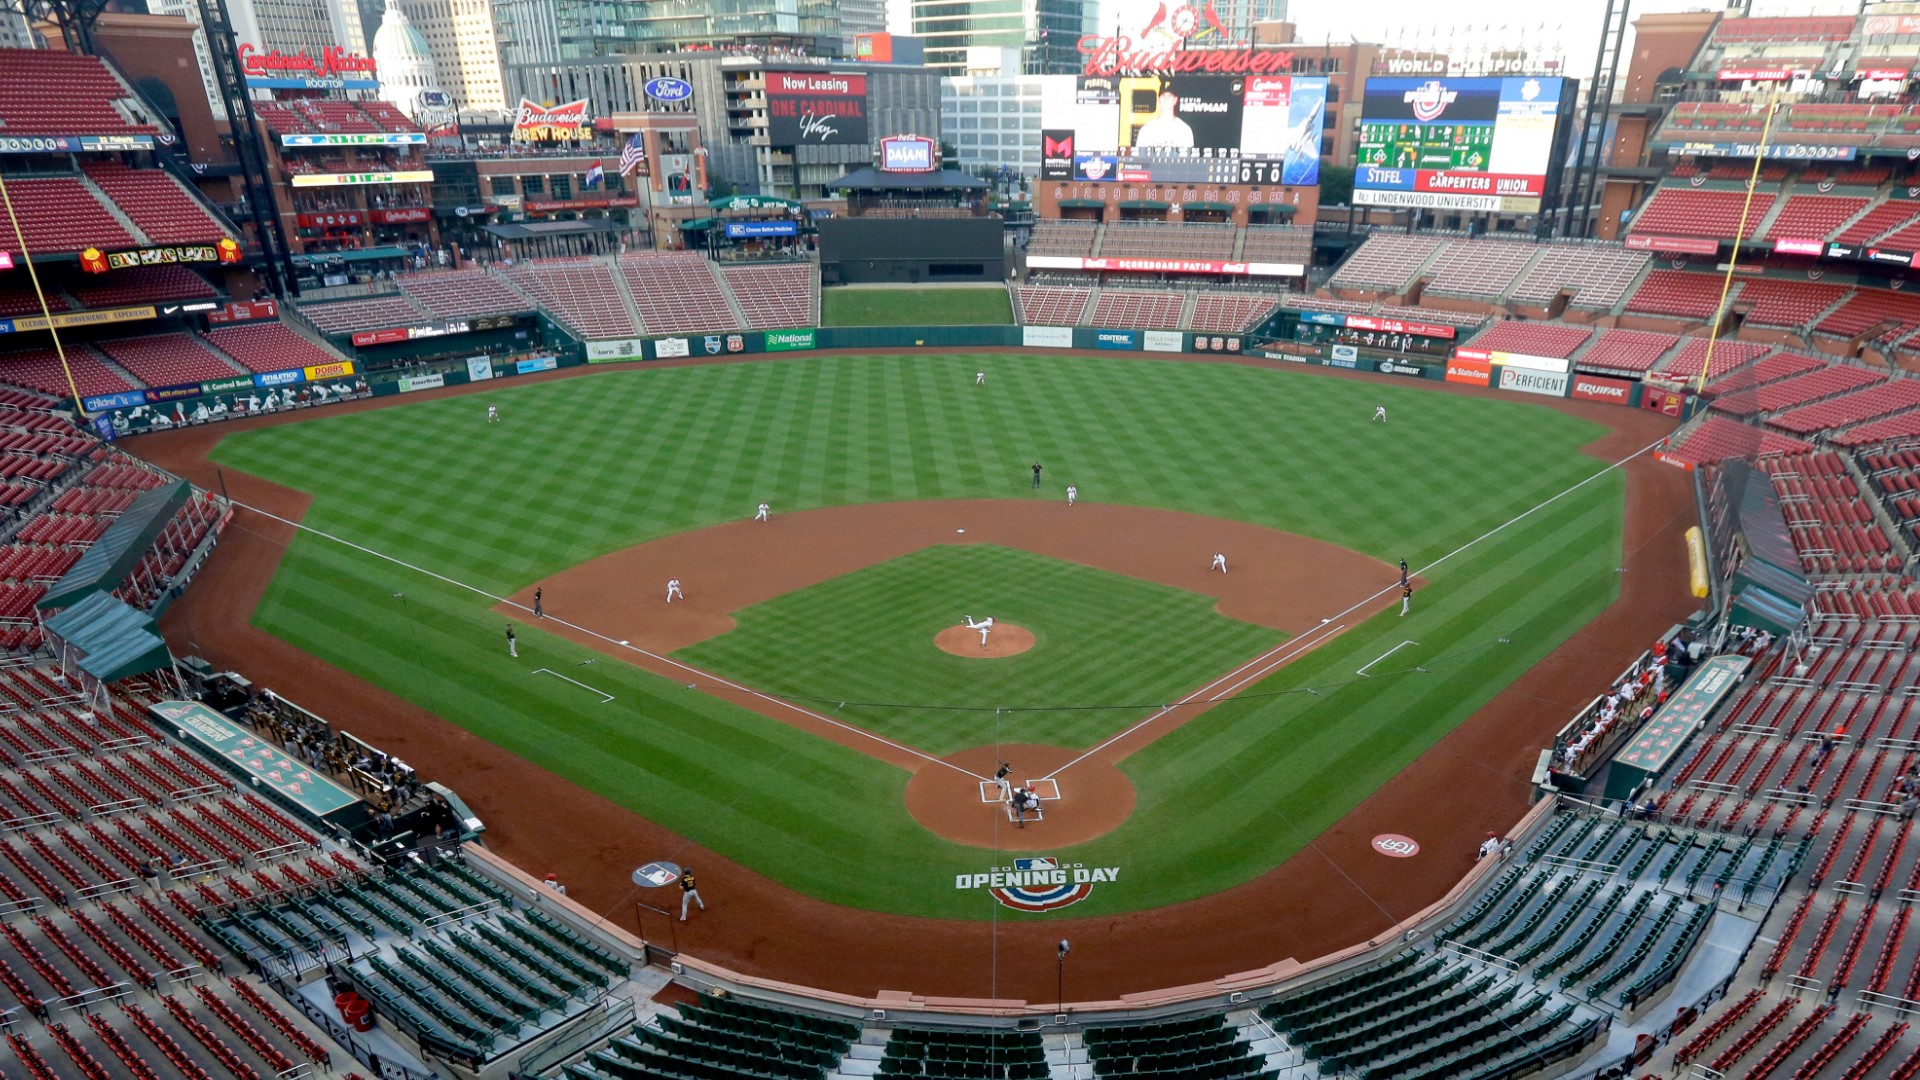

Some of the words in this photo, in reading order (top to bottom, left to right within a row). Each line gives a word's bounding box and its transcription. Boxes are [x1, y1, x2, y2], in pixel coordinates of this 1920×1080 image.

[238, 43, 315, 75] Cardinals
[315, 46, 377, 76] Nation
[1077, 35, 1294, 75] Budweiser
[1388, 59, 1444, 72] WORLD
[305, 79, 344, 88] ROOFTOP
[655, 81, 684, 97] Ford
[783, 77, 807, 90] Now
[808, 77, 848, 92] Leasing
[424, 91, 445, 106] FOX
[771, 101, 797, 116] ONE
[801, 100, 862, 116] CARDINAL
[1179, 103, 1228, 112] NEWMAN
[417, 111, 457, 127] MIDWEST
[517, 108, 589, 125] Budweiser
[799, 110, 838, 141] Way
[515, 127, 549, 141] BREW
[552, 127, 592, 140] HOUSE
[887, 145, 928, 164] DASANI
[1241, 168, 1250, 181] 0
[1256, 168, 1263, 181] 1
[1270, 168, 1280, 182] 0
[1367, 168, 1402, 183] STIFEL
[1428, 176, 1491, 190] CARPENTERS
[1496, 178, 1528, 191] UNION
[1128, 188, 1138, 200] 10
[1146, 189, 1157, 200] 14
[1164, 189, 1176, 201] 17
[1183, 189, 1197, 201] 20
[1226, 190, 1240, 203] 42
[1373, 192, 1435, 205] LINDENWOOD
[1437, 195, 1497, 209] UNIVERSITY
[1628, 239, 1646, 248] Mercy
[108, 251, 140, 269] BIG
[140, 248, 177, 264] MAC
[177, 246, 217, 261] LAND
[1119, 260, 1180, 270] SCOREBOARD
[1183, 262, 1211, 271] PATIO
[21, 318, 59, 328] FLEXIBILTY
[66, 314, 107, 324] CONVENIENCE
[114, 309, 150, 319] EXPERIENCE
[778, 333, 812, 343] National
[1098, 334, 1130, 342] CENTENE
[1264, 352, 1282, 360] BUSCH
[1283, 354, 1307, 363] STADIUM
[261, 371, 298, 382] ATHLETICO
[315, 366, 344, 375] DOBBS
[1394, 365, 1420, 374] MIDWEST
[212, 381, 235, 391] Central
[236, 378, 253, 387] Bank
[1501, 369, 1565, 391] PERFICIENT
[1576, 383, 1624, 396] EQUIFAX
[955, 870, 1067, 889] OPENING
[1073, 867, 1120, 883] DAY
